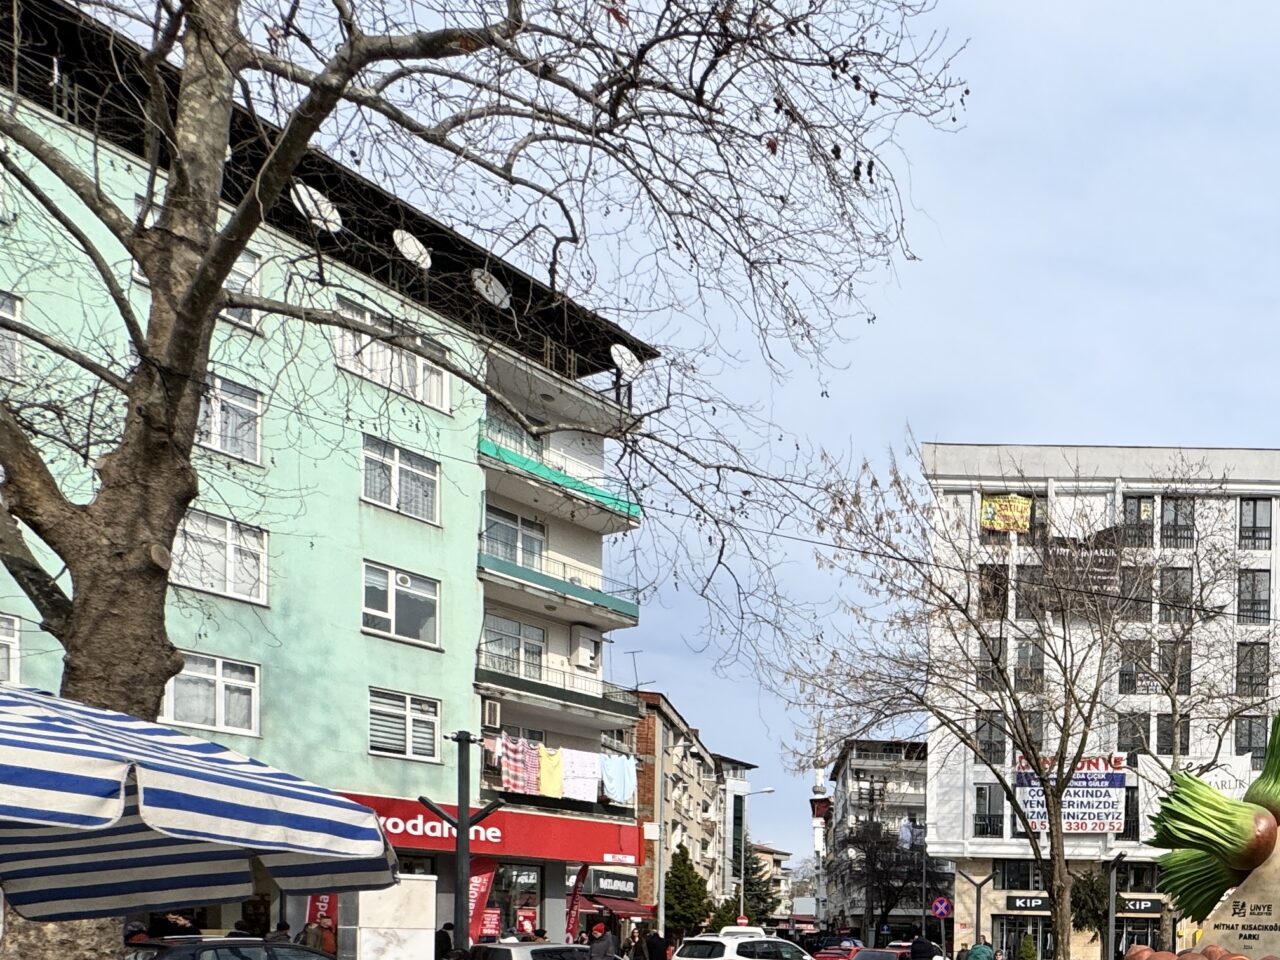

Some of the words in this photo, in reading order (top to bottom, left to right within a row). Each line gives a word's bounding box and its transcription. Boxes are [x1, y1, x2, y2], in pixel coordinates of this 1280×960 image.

[1062, 789, 1112, 799] AKINDA
[1023, 800, 1046, 809] YEN
[1061, 800, 1119, 810] ERİMİZDE
[379, 814, 502, 843] vodafne
[1066, 822, 1088, 831] 330
[1091, 822, 1105, 831] 20
[1109, 822, 1123, 832] 52
[1213, 923, 1239, 931] MİTHAT
